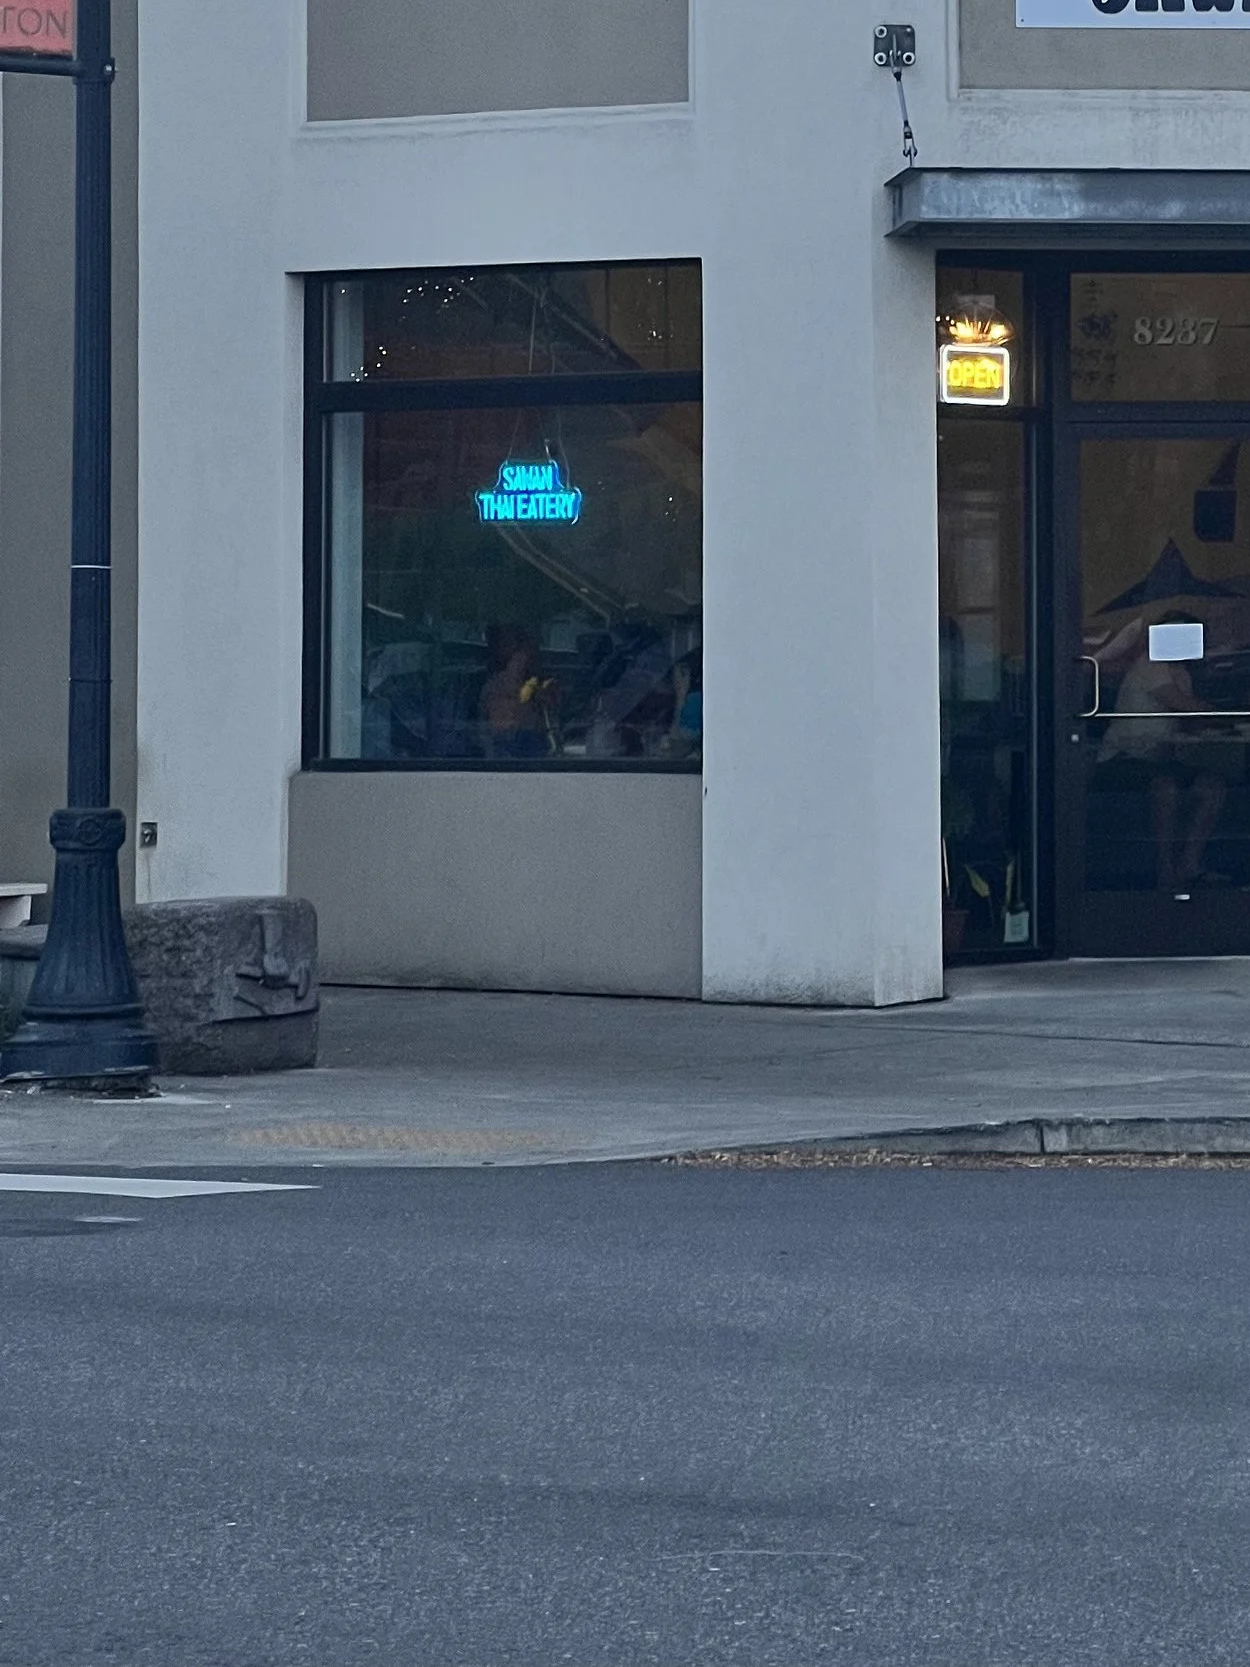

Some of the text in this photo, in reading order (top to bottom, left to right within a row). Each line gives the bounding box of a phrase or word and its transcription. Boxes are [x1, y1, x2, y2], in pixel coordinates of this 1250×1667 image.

[949, 359, 1001, 389] OPEN
[502, 465, 553, 491] SAWAN
[479, 493, 576, 520] THAI EATERY
